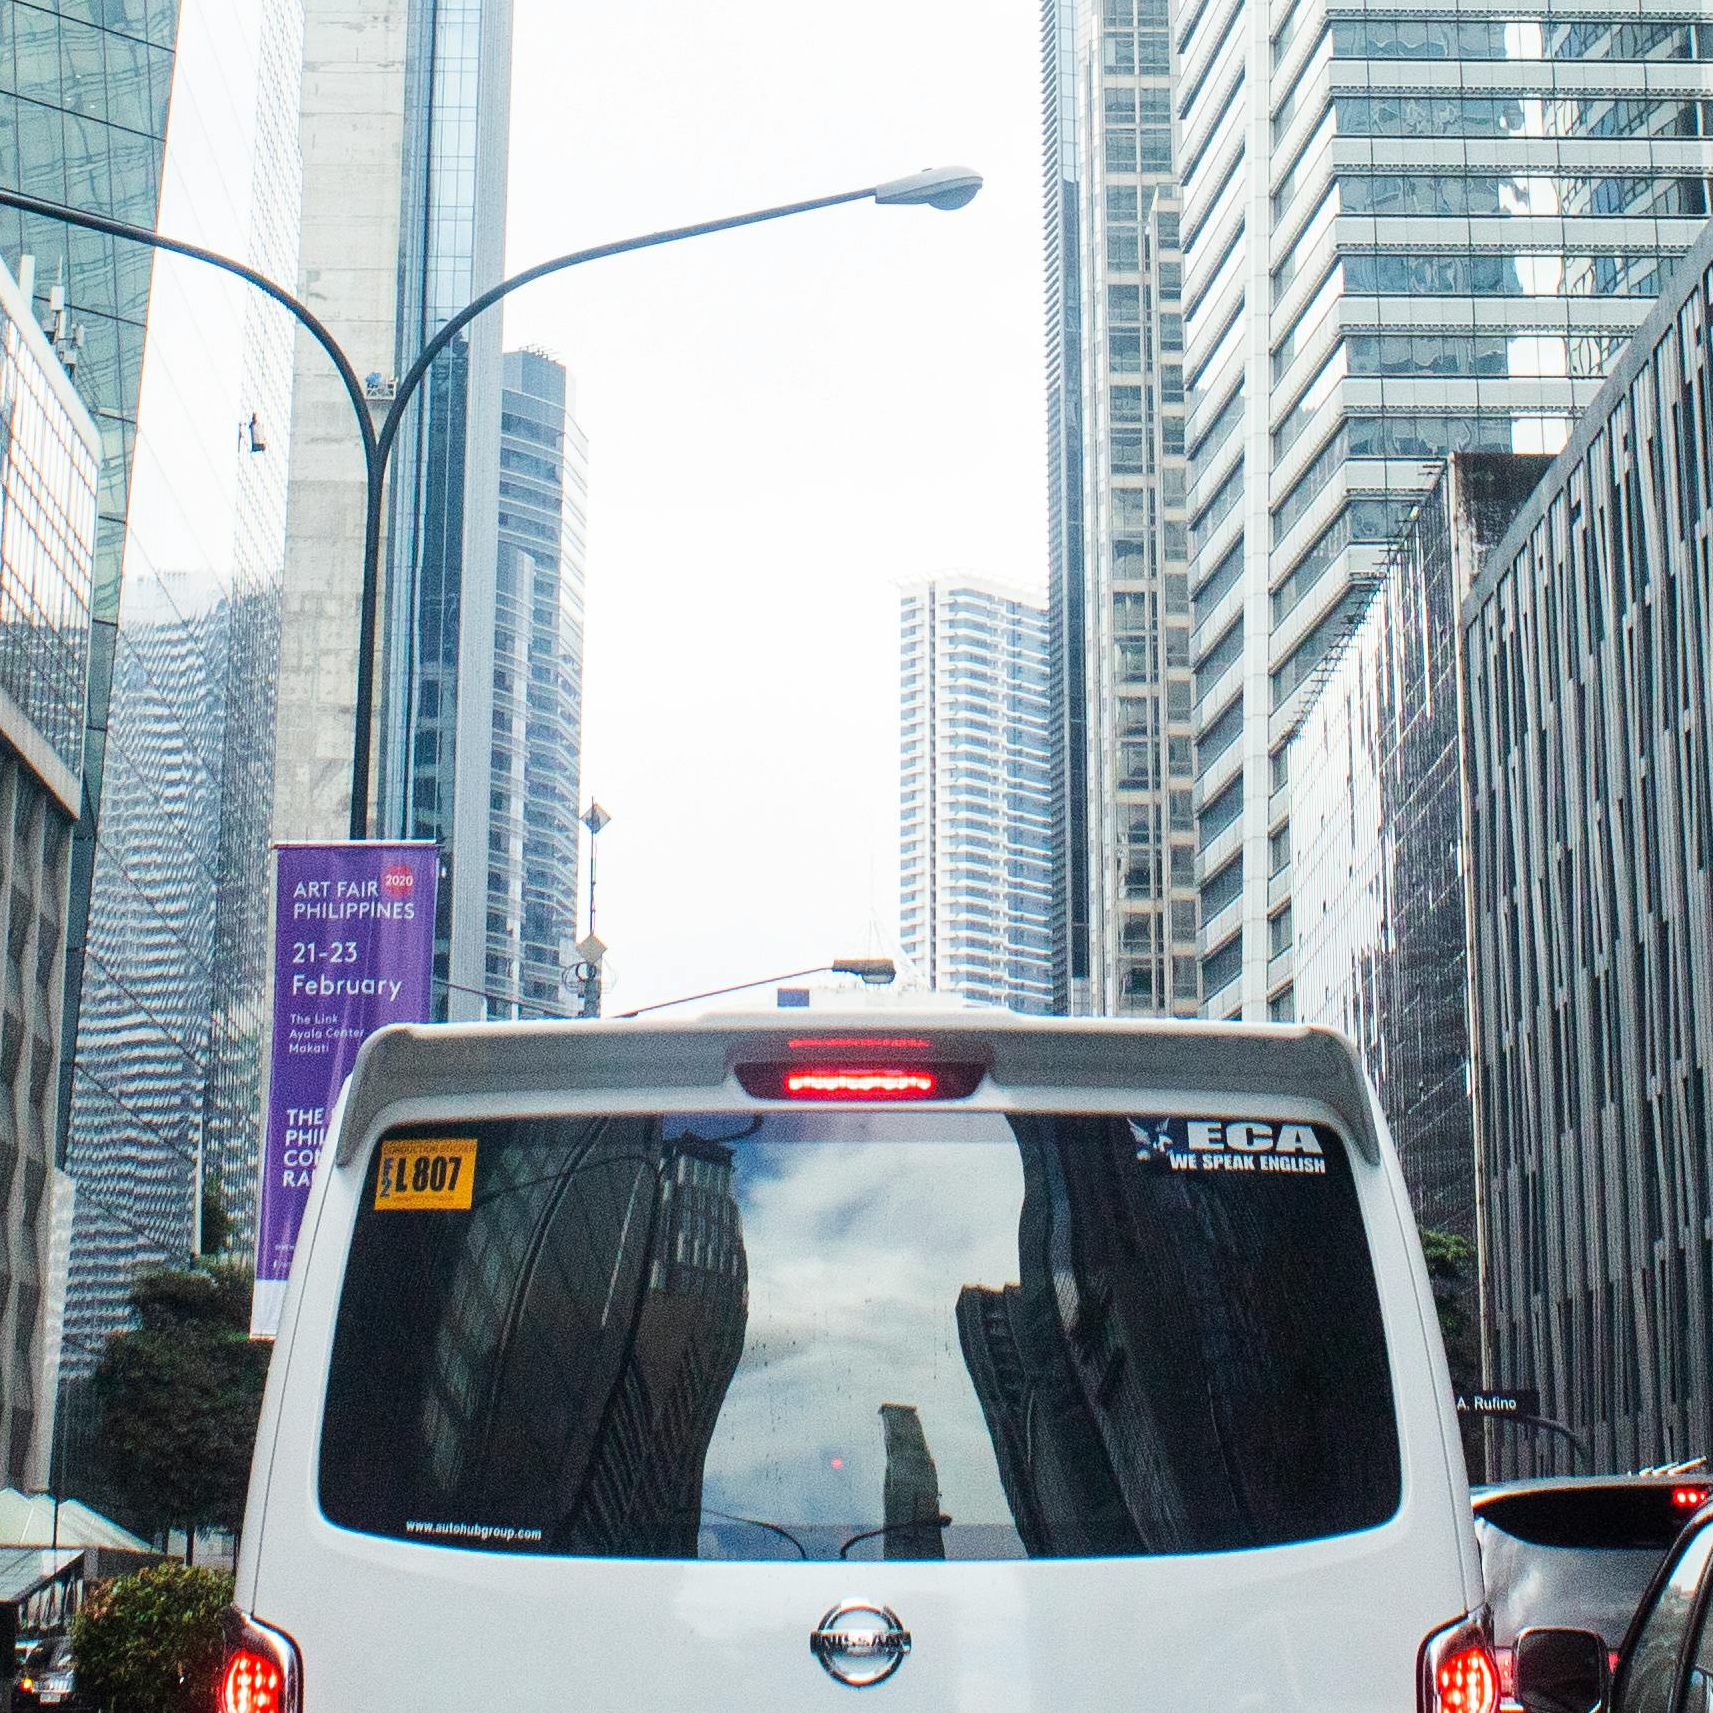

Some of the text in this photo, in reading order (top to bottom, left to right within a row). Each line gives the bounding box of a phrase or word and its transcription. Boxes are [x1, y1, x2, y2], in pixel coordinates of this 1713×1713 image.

[293, 880, 379, 898] ART FAIR
[385, 874, 413, 887] 2020
[293, 901, 415, 920] PHILIPPINES
[292, 941, 358, 964] 21-23
[292, 973, 403, 1002] February
[290, 1013, 338, 1025] The Link
[289, 1027, 365, 1041] Ayala Center
[289, 1043, 329, 1054] Makati
[286, 1107, 325, 1126] THE
[1186, 1120, 1323, 1153] ECA
[1169, 1153, 1326, 1174] WE SPEAK ENGLISH
[1474, 1395, 1517, 1411] Rufino
[405, 1519, 543, 1542] www.autohubgroup.com
